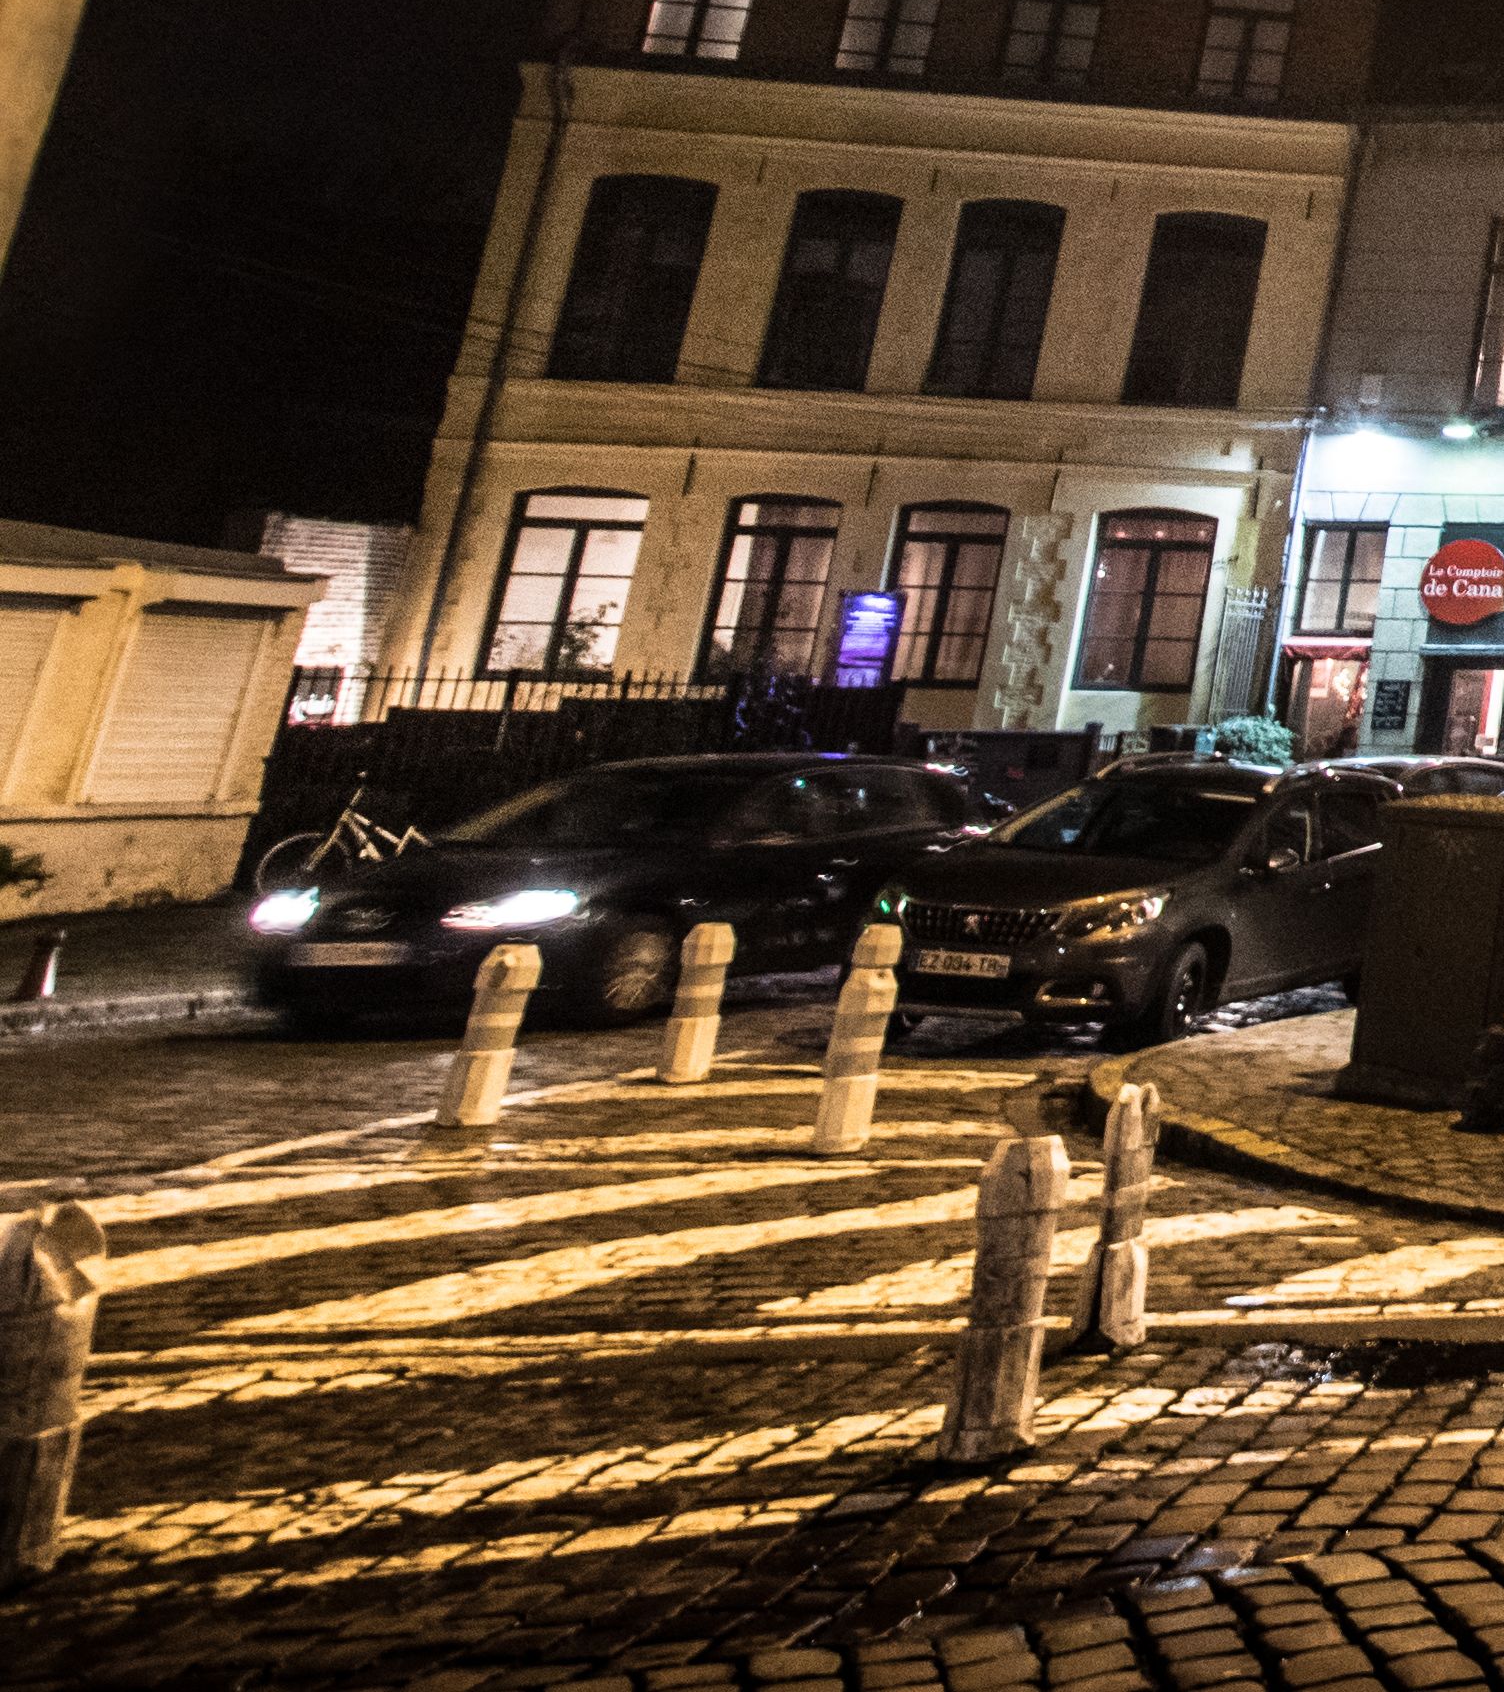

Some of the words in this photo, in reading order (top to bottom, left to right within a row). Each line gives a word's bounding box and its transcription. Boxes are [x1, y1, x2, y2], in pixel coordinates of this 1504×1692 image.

[1447, 564, 1503, 580] Comptoir
[1423, 578, 1448, 598] de
[1452, 578, 1503, 598] Cana
